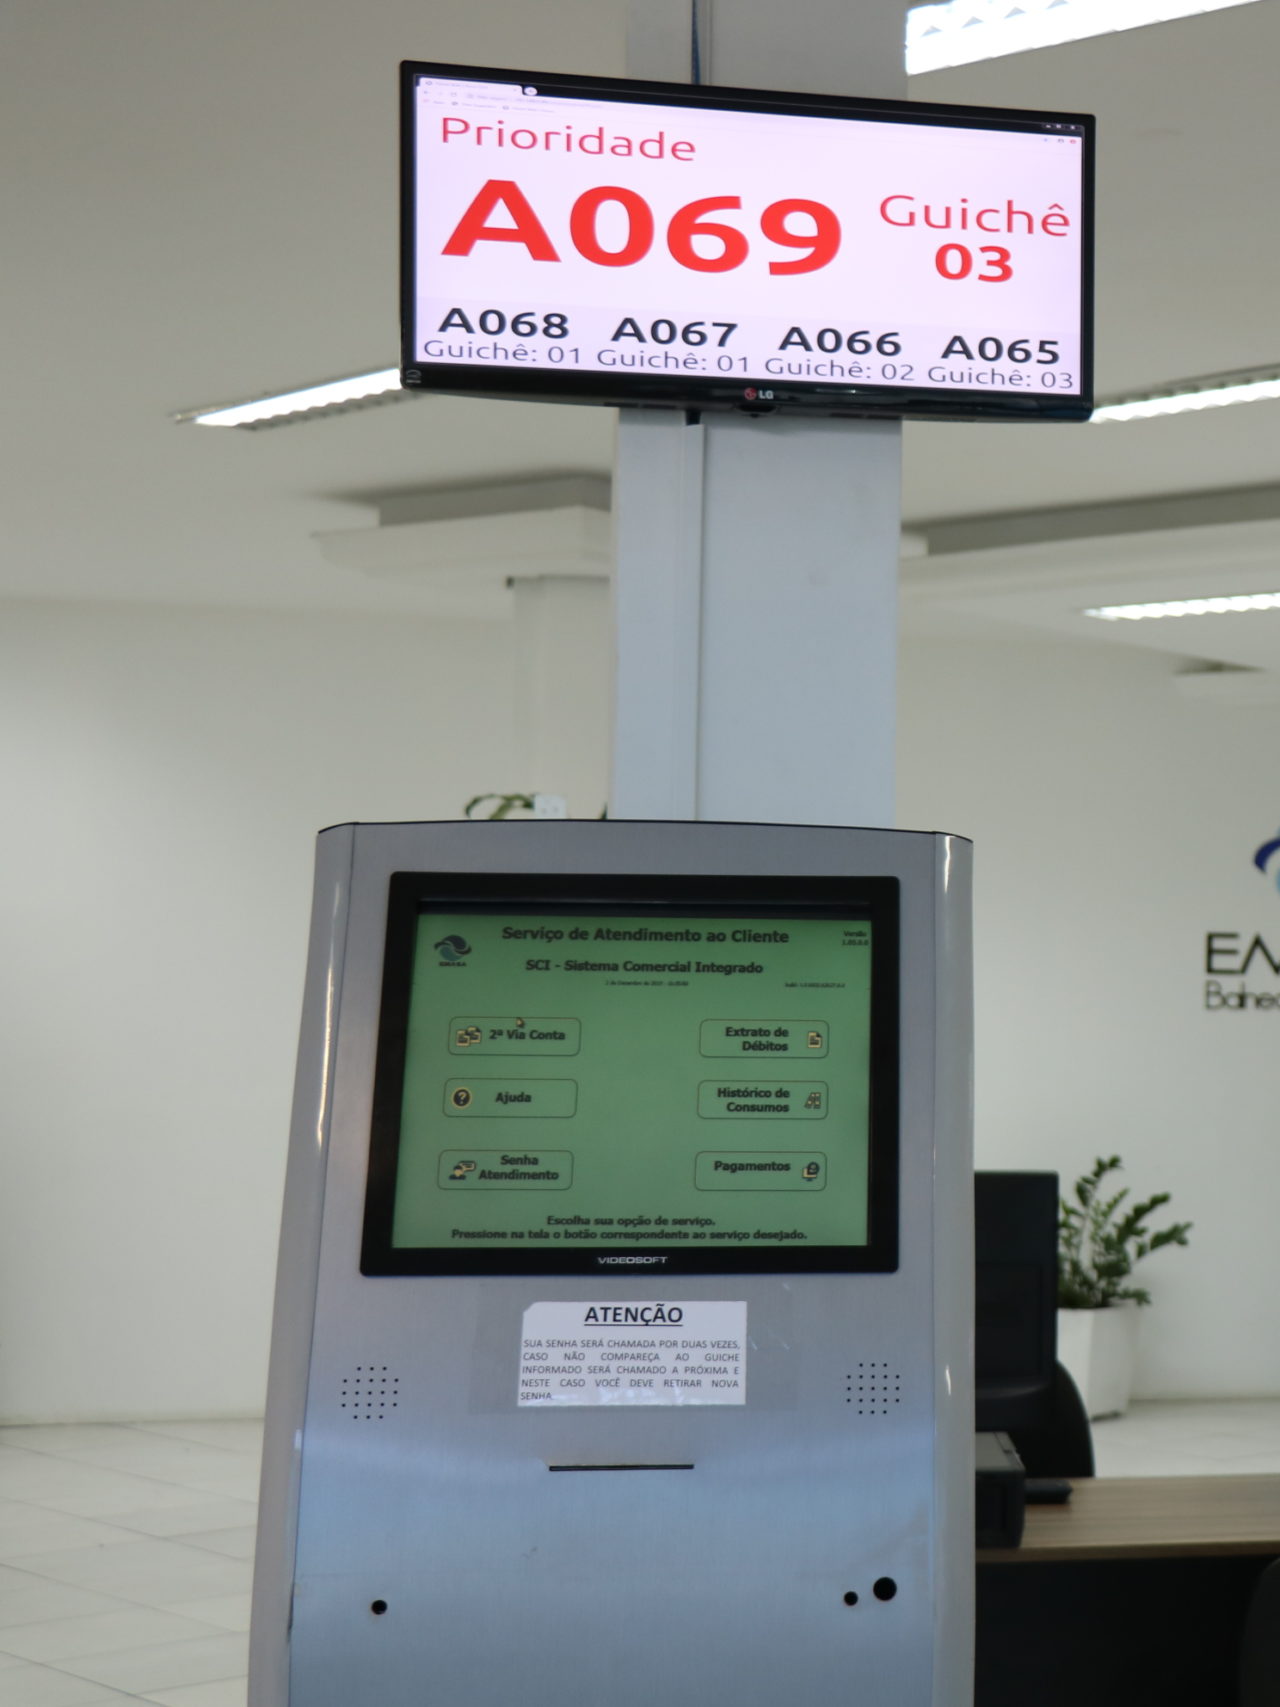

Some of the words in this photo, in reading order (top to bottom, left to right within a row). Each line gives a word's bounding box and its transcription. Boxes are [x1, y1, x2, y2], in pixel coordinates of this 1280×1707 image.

[441, 116, 697, 161] Prioridade
[879, 194, 1071, 237] Guichê
[440, 178, 842, 276] A069
[934, 242, 1014, 283] 03
[438, 307, 569, 339] A068
[611, 317, 738, 348] A067
[778, 326, 902, 356] A066
[423, 340, 538, 362] Guichê:
[548, 346, 580, 364] 01
[941, 335, 1060, 365] A065
[597, 349, 707, 370] Guichê:
[717, 355, 749, 373] 01
[765, 358, 872, 379] Guichê:
[881, 363, 915, 382] 02
[928, 366, 1031, 387] Guichê:
[1041, 372, 1073, 389] 03
[758, 390, 774, 399] LG
[502, 926, 564, 943] Serviço
[569, 927, 589, 941] de
[594, 927, 701, 942] Atendimento
[706, 931, 726, 942] ao
[732, 929, 789, 943] Cliente
[526, 960, 550, 971] SCI
[564, 960, 619, 972] Sistema
[623, 961, 690, 972] Comercial
[695, 961, 763, 975] Integrado
[507, 1029, 525, 1040] Via
[529, 1030, 566, 1040] Conta
[725, 1026, 771, 1037] Extrato
[774, 1027, 789, 1037] de
[742, 1041, 789, 1052] Débitos
[495, 1092, 532, 1105] Ajuda
[717, 1087, 772, 1099] Histórico
[775, 1088, 790, 1098] de
[726, 1102, 790, 1113] Consumos
[500, 1154, 539, 1166] Senha
[714, 1160, 791, 1173] Pagamentos
[478, 1169, 559, 1181] Atendimento
[547, 1215, 591, 1226] Escolha
[594, 1217, 614, 1226] sua
[617, 1215, 651, 1228] opção
[654, 1215, 668, 1226] de
[671, 1216, 715, 1228] serviço.
[451, 1228, 507, 1239] Pressione
[511, 1230, 524, 1239] na
[528, 1229, 549, 1239] tela
[553, 1230, 561, 1239] o
[564, 1229, 597, 1239] botão
[601, 1229, 689, 1241] correspondente
[692, 1230, 706, 1239] ao
[710, 1230, 750, 1241] serviço
[753, 1229, 807, 1241] desejado.
[598, 1256, 668, 1264] VIDEOSOFT
[584, 1303, 683, 1326] ATENÇÃO
[523, 1339, 543, 1348] SUA
[546, 1339, 577, 1348] SENHA
[581, 1338, 604, 1348] SERÁ
[607, 1339, 656, 1349] CHAMADA
[659, 1340, 678, 1349] POR
[682, 1340, 707, 1349] DUAS
[711, 1340, 740, 1350] VEZES,
[523, 1353, 548, 1361] CASO
[564, 1351, 585, 1361] NÃO
[601, 1353, 660, 1363] COMPAREÇA
[675, 1353, 690, 1362] AO
[522, 1365, 582, 1374] INFORMADO
[587, 1363, 611, 1374] SERÁ
[617, 1365, 667, 1374] CHAMADO
[672, 1366, 679, 1374] A
[684, 1364, 728, 1375] PRÓXIMA
[734, 1366, 739, 1375] E
[521, 1378, 551, 1387] NESTE
[559, 1378, 585, 1387] CASO
[595, 1377, 621, 1387] VOCÊ
[629, 1379, 654, 1388] DEVE
[664, 1379, 702, 1388] RETIRAR
[711, 1379, 739, 1388] NOVA
